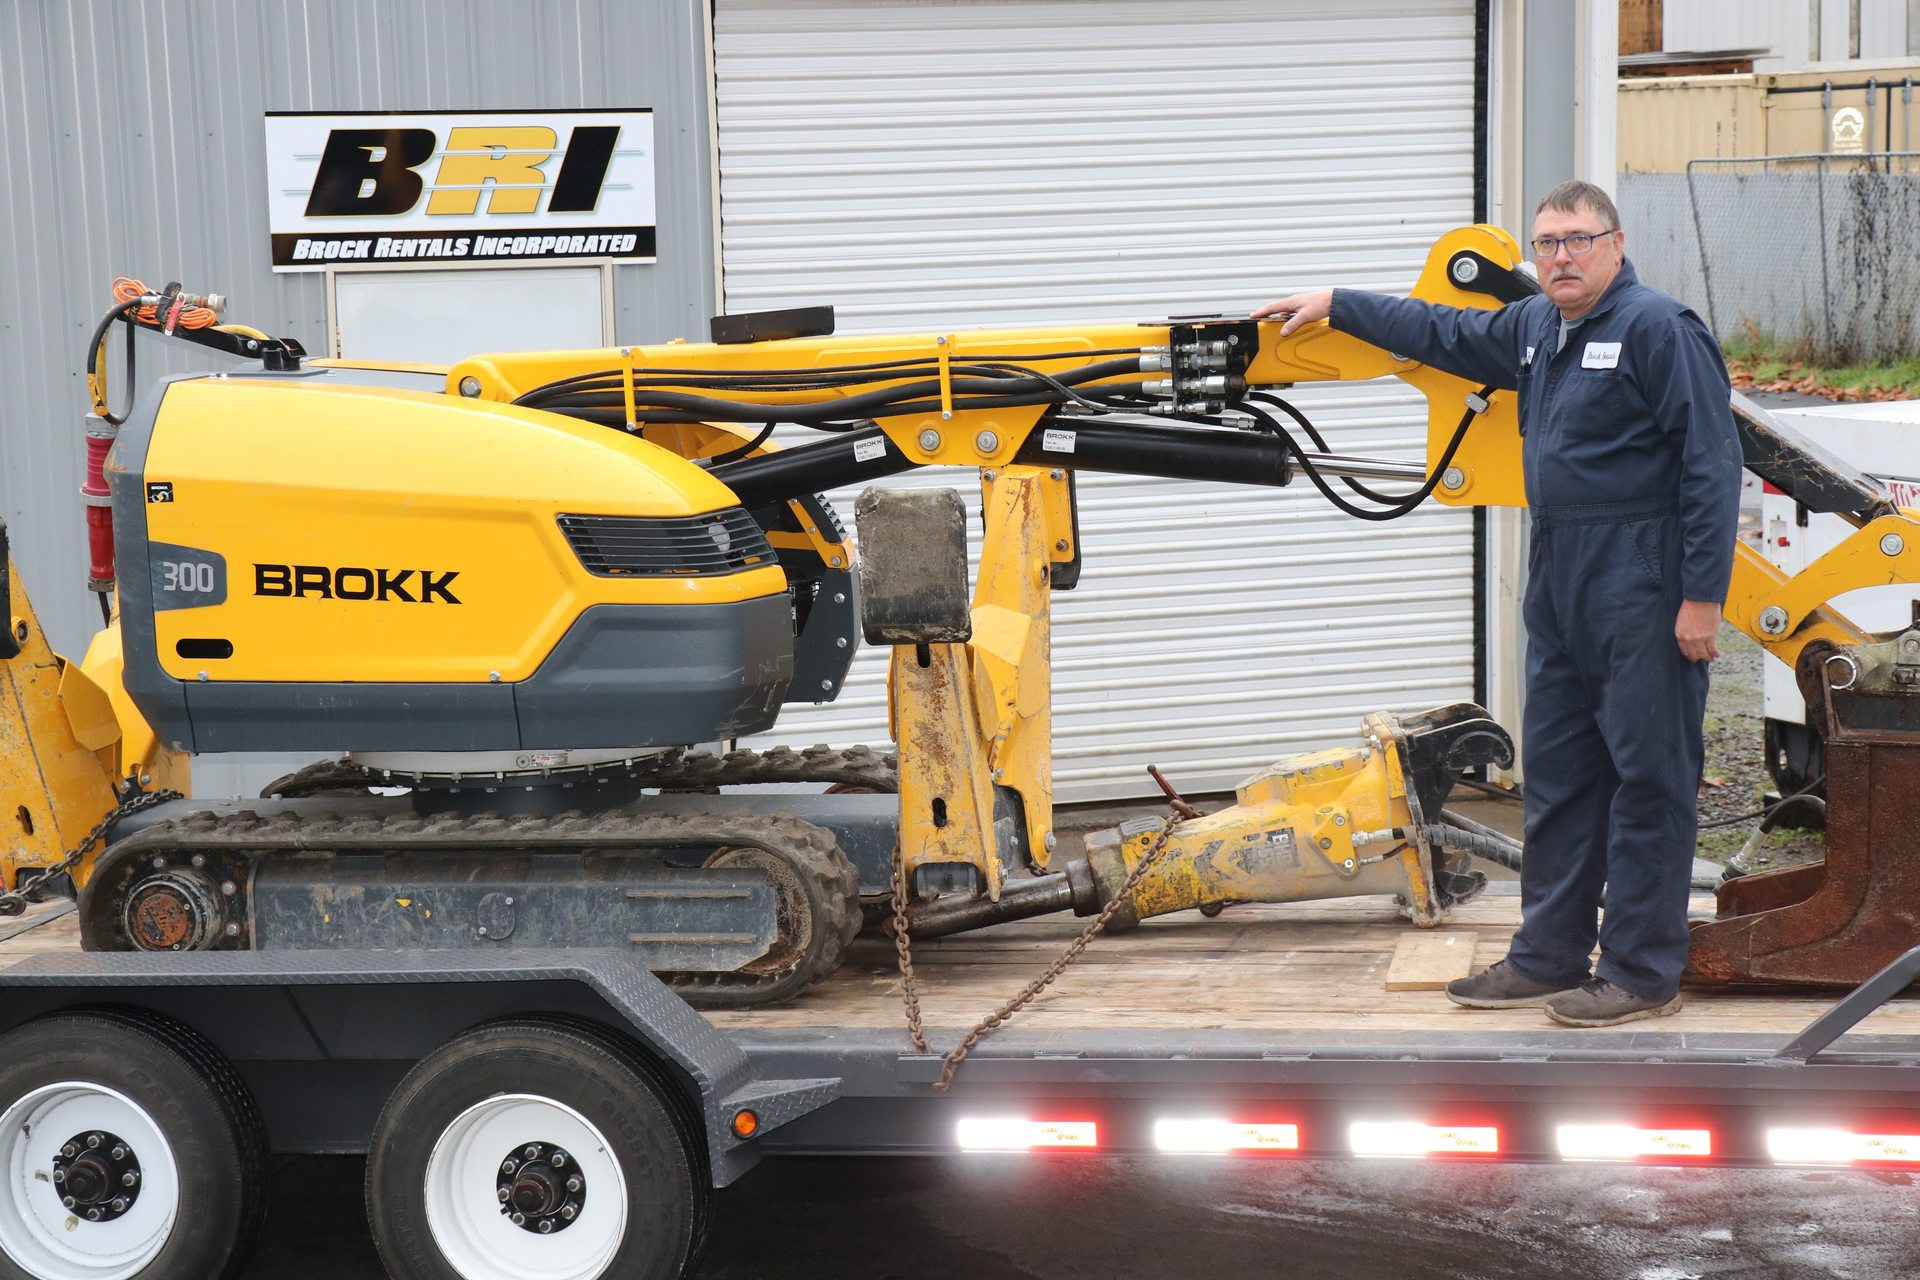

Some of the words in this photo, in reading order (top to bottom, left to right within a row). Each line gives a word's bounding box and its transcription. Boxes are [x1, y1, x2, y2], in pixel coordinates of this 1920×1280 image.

[303, 125, 622, 218] BRI
[293, 238, 373, 260] BROCK
[374, 236, 471, 258] RENTALS
[473, 234, 637, 256] INCORPORATED
[856, 439, 882, 450] BROKK
[163, 561, 214, 593] 300
[252, 563, 463, 604] BROKK
